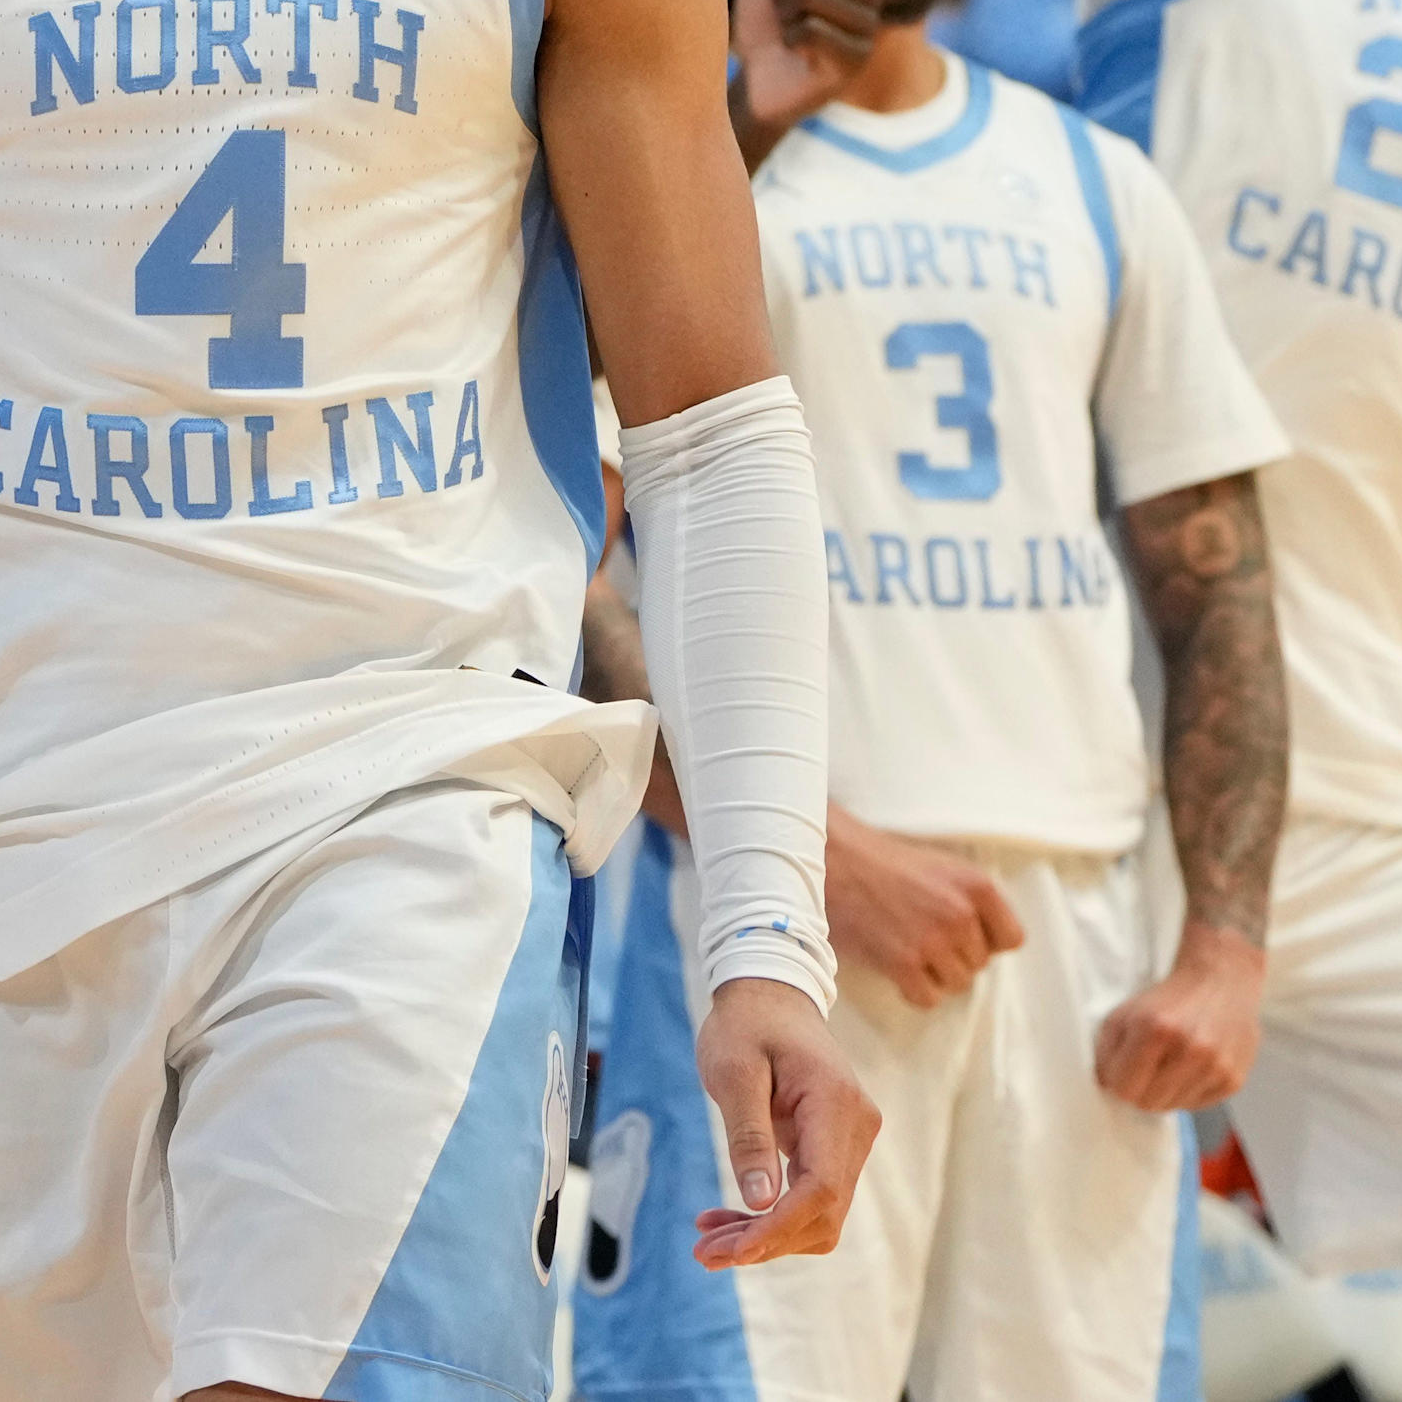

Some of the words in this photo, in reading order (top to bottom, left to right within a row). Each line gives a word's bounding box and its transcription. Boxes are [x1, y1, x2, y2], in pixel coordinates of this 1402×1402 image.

[135, 130, 307, 389] 4
[793, 222, 1059, 308] NORTH
[885, 322, 1003, 503] 3
